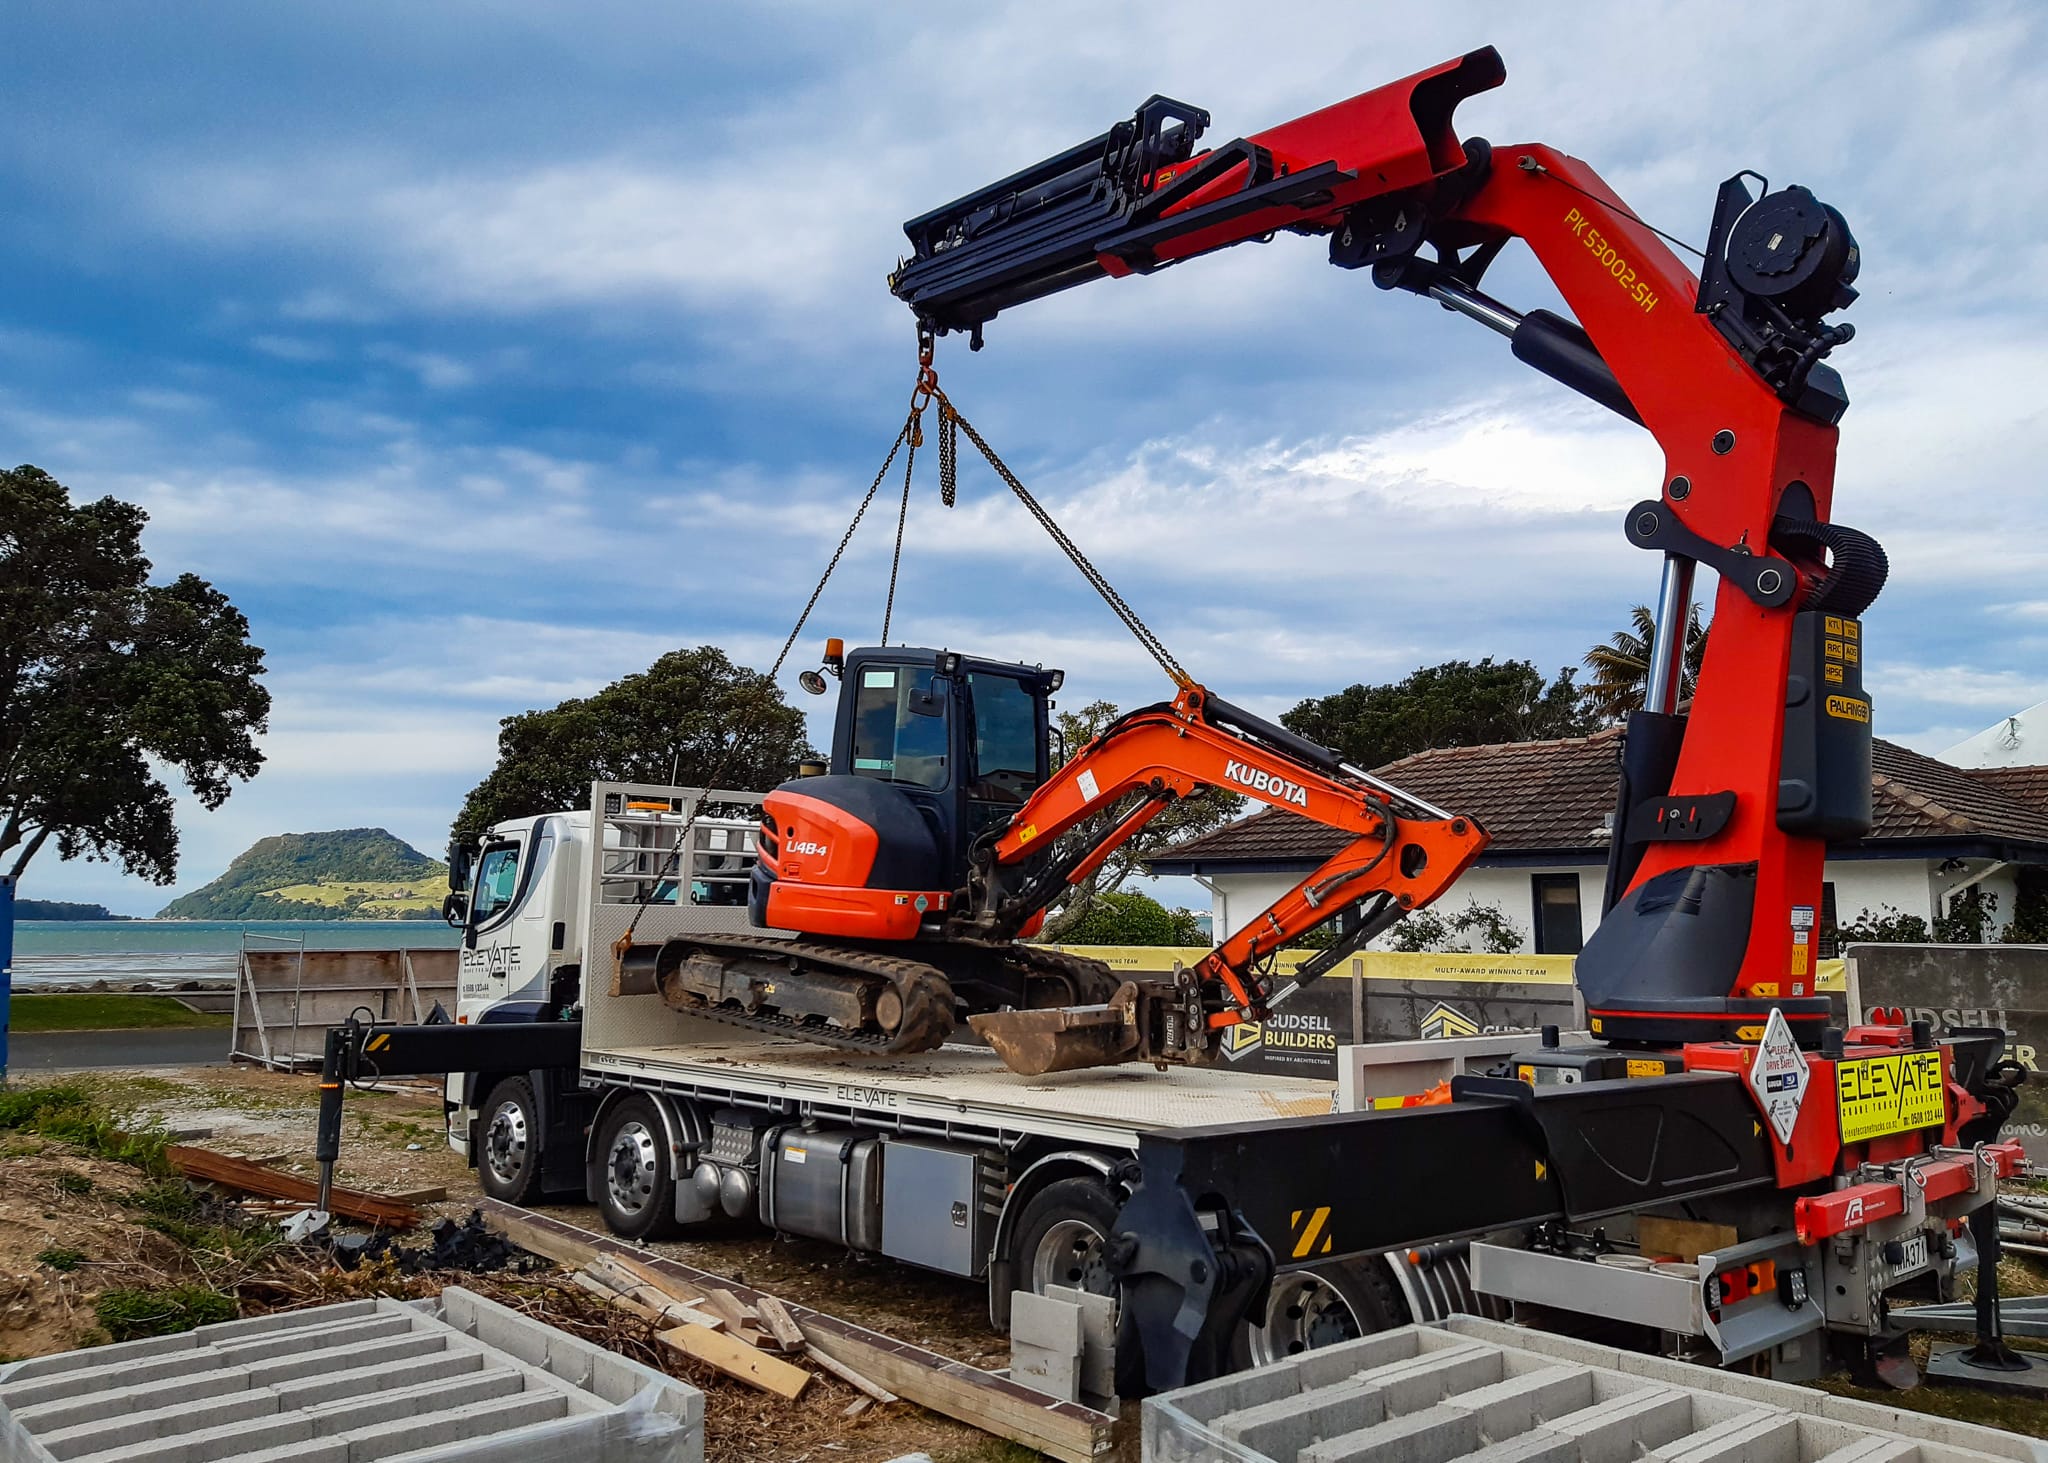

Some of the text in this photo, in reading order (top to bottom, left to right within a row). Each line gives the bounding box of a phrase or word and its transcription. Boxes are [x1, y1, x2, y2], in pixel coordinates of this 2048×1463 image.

[1564, 208, 1659, 313] PK 53002-SH
[1830, 699, 1868, 718] PALFINGER
[1224, 759, 1308, 807] KUBOTA
[463, 940, 520, 973] ELEVATE
[1267, 1014, 1331, 1031] GUDSELL
[1264, 1031, 1336, 1050] BUILDERS
[837, 1085, 897, 1107] ELEVATE
[1840, 1055, 1942, 1112] ELEVATE
